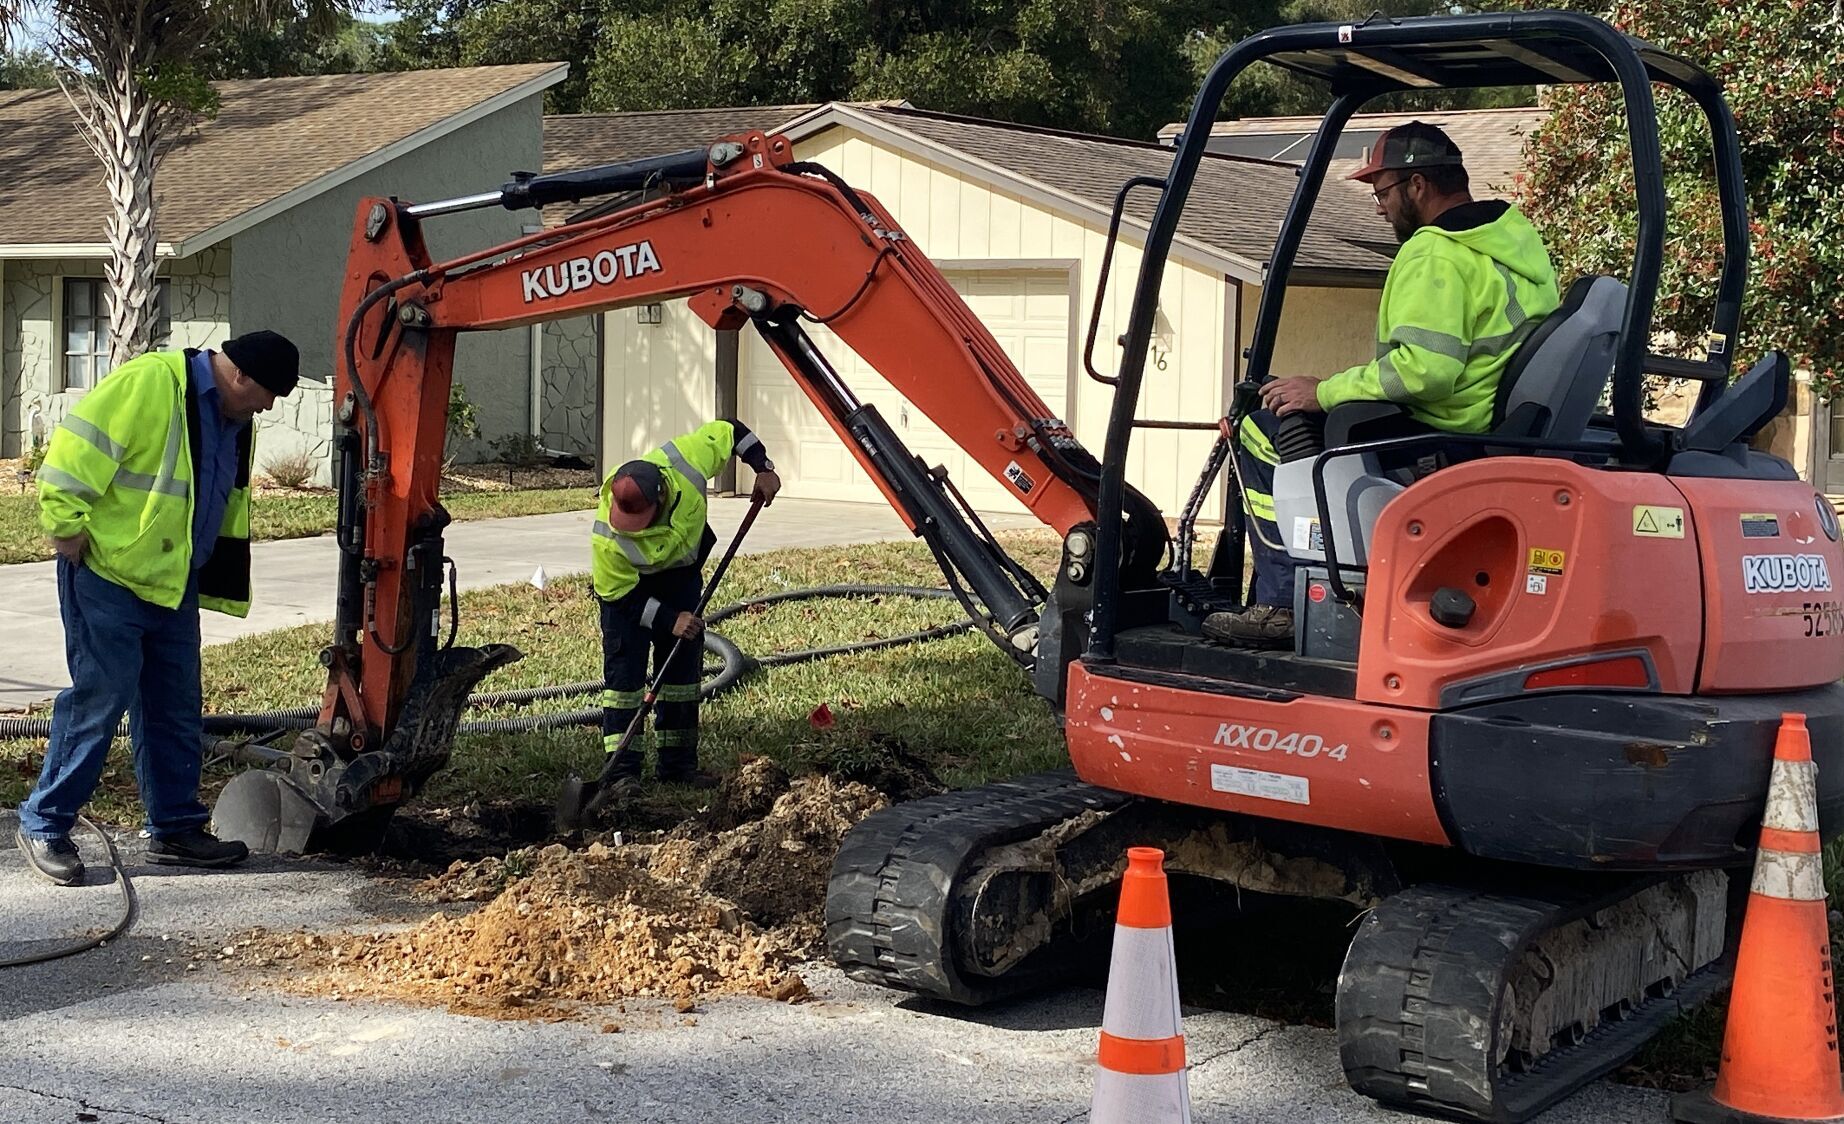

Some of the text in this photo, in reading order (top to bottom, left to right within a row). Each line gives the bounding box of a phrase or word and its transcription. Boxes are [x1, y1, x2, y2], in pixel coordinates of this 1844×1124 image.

[521, 240, 662, 302] KUBOTA
[1744, 556, 1831, 590] KUBOTA
[1213, 723, 1349, 762] KX040-4
